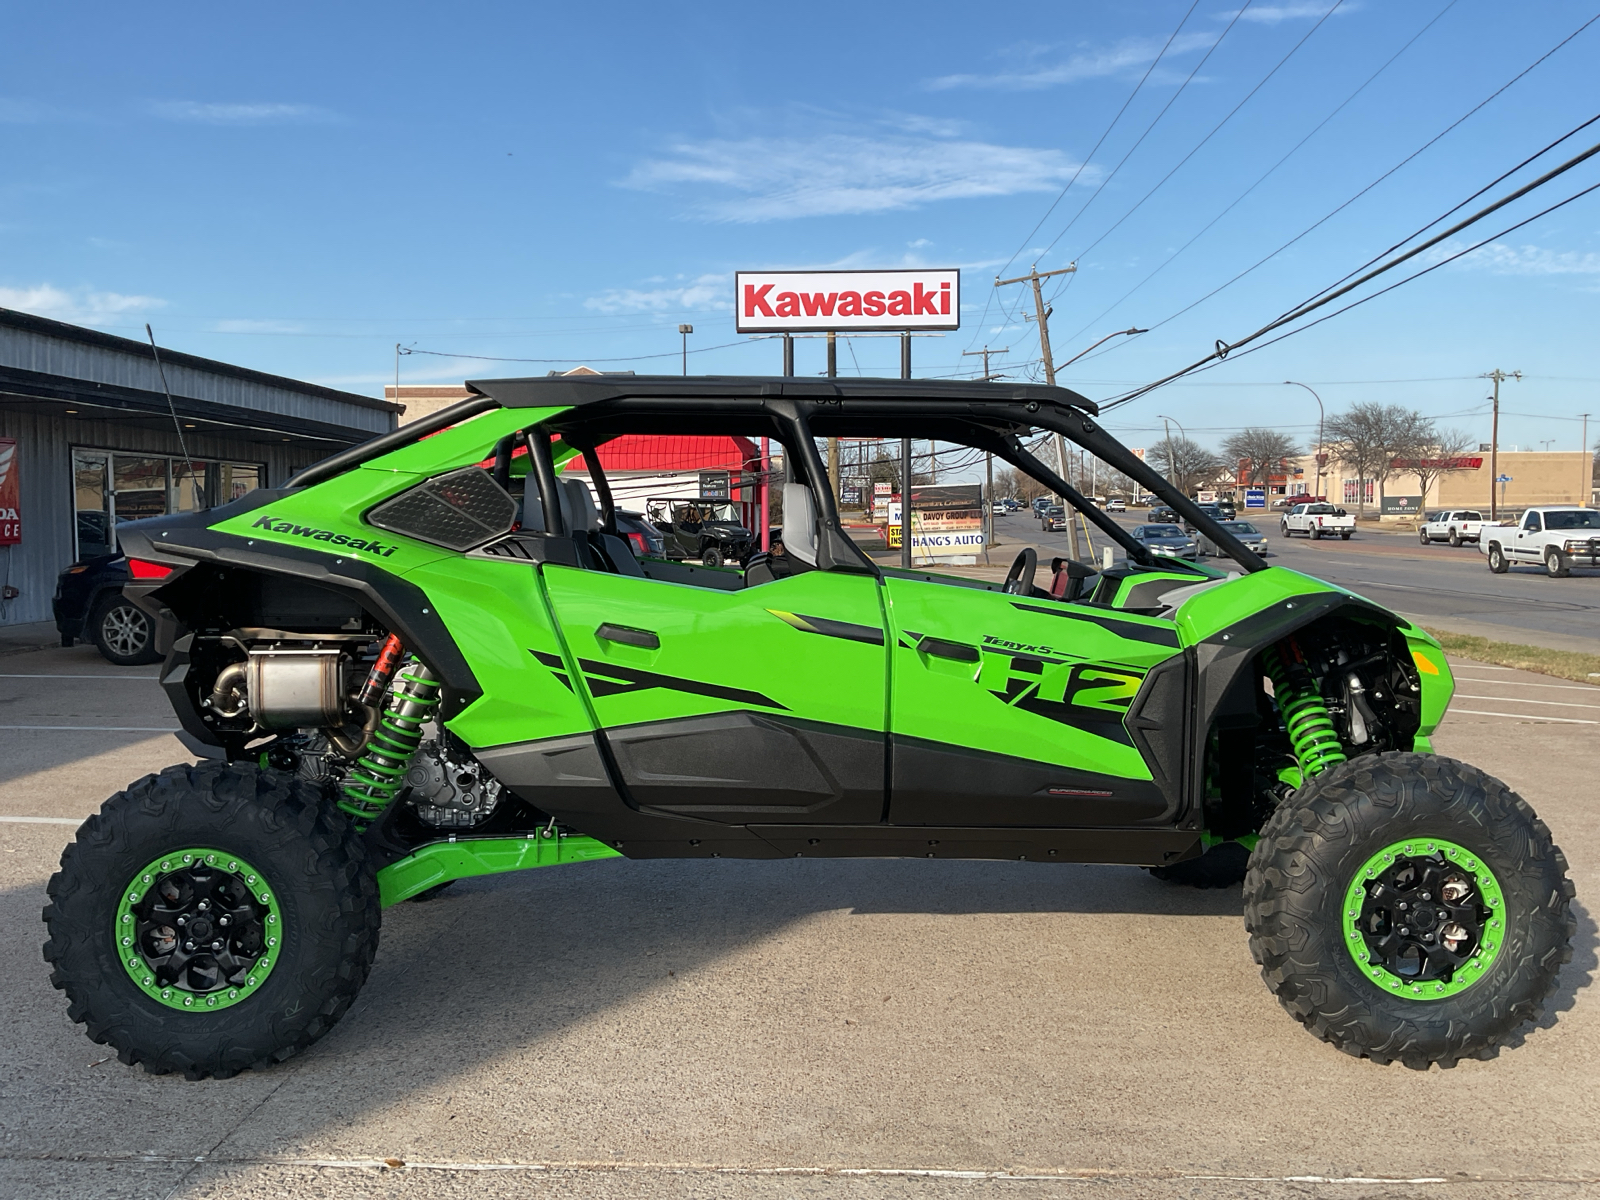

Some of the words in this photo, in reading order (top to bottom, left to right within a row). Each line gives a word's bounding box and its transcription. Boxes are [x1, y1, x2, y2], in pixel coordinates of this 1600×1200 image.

[744, 282, 951, 318] Kawasaki
[923, 512, 945, 521] DAVOY
[945, 510, 968, 520] GROUP
[251, 515, 399, 558] Kawasaki
[954, 535, 984, 545] AUTO
